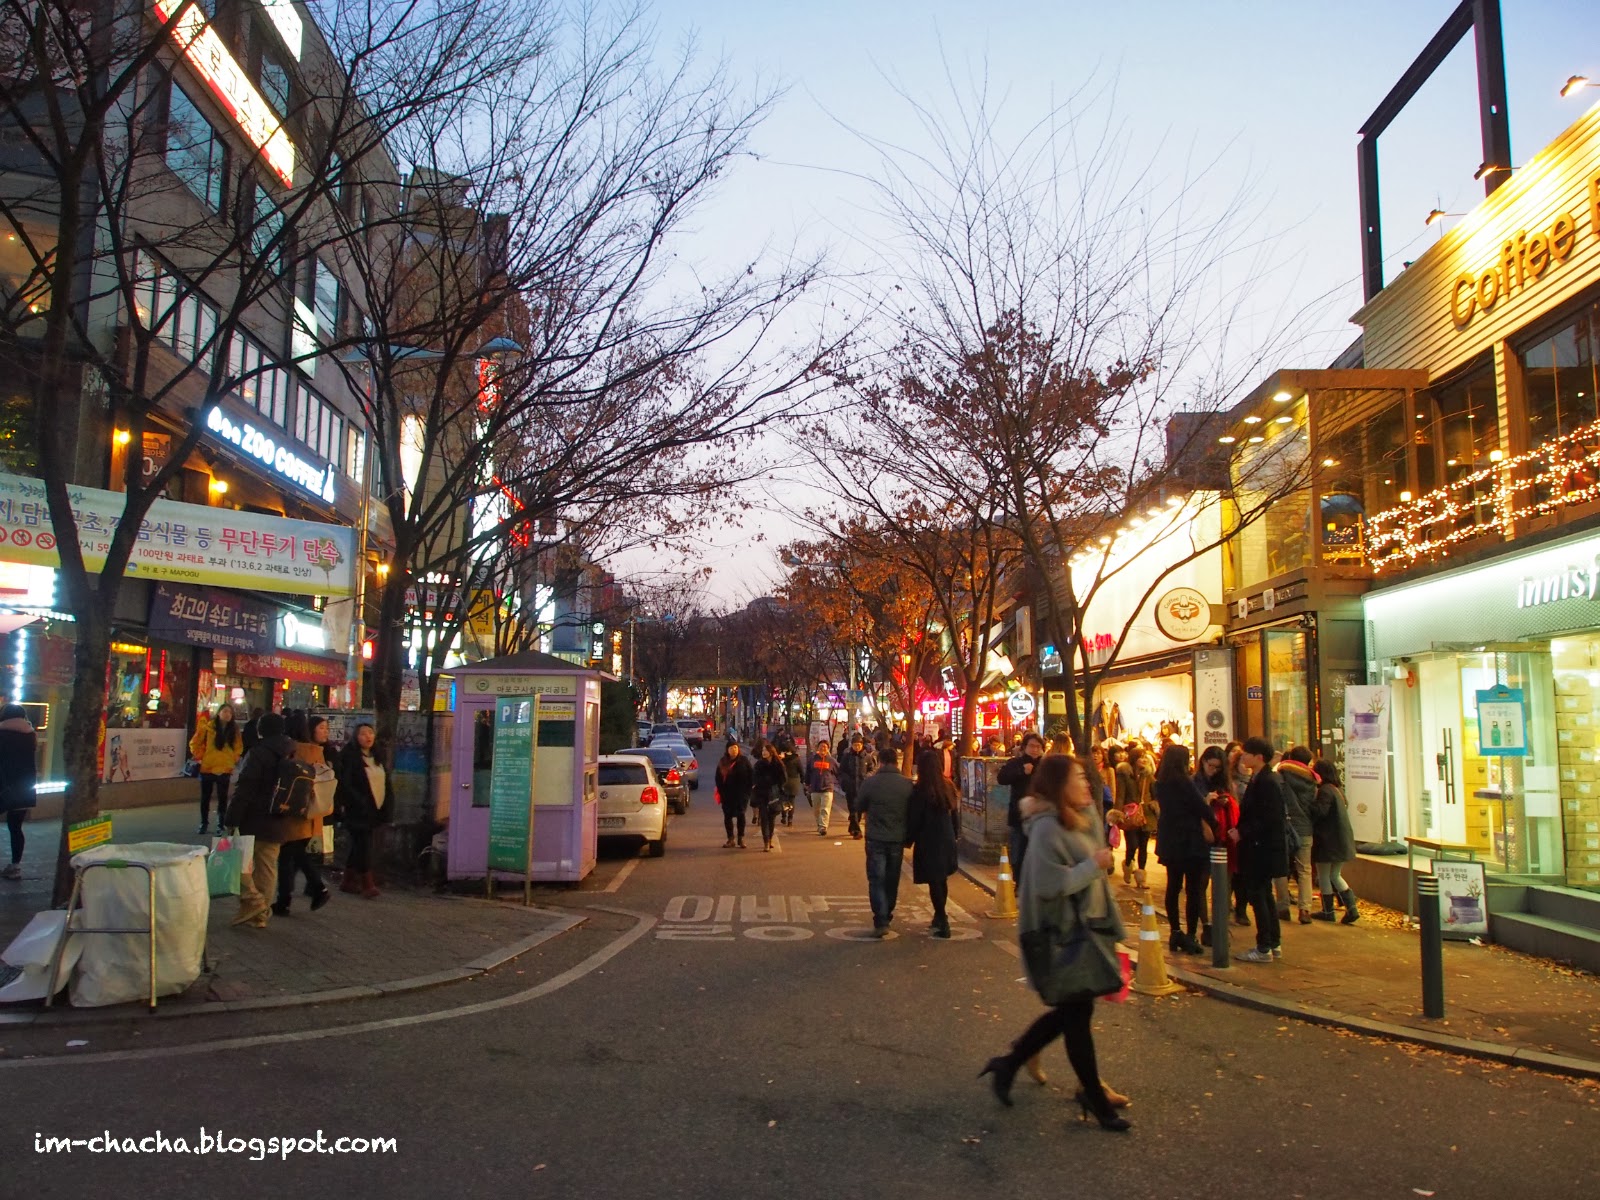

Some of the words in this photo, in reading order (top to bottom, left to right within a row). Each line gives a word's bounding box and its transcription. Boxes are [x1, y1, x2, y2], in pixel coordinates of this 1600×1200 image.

[1451, 213, 1575, 327] Coffee
[241, 424, 275, 465] ZOO
[275, 447, 324, 497] COFFEE
[195, 527, 212, 549] 등
[219, 527, 296, 560] 무단투기
[303, 539, 339, 565] 단속
[138, 549, 174, 561] 100만원
[177, 553, 205, 564] 과태료
[208, 556, 227, 567] 부과
[265, 563, 290, 575] 과태료
[292, 567, 311, 578] 인상)
[169, 569, 200, 579] MAPOGU
[169, 592, 210, 624] 최고의
[209, 603, 231, 627] 속도
[1164, 596, 1179, 609] Coffee
[1188, 596, 1205, 608] Brown
[497, 685, 568, 694] 마포구시설관리공단
[502, 706, 511, 721] P
[1204, 737, 1228, 745] Brown
